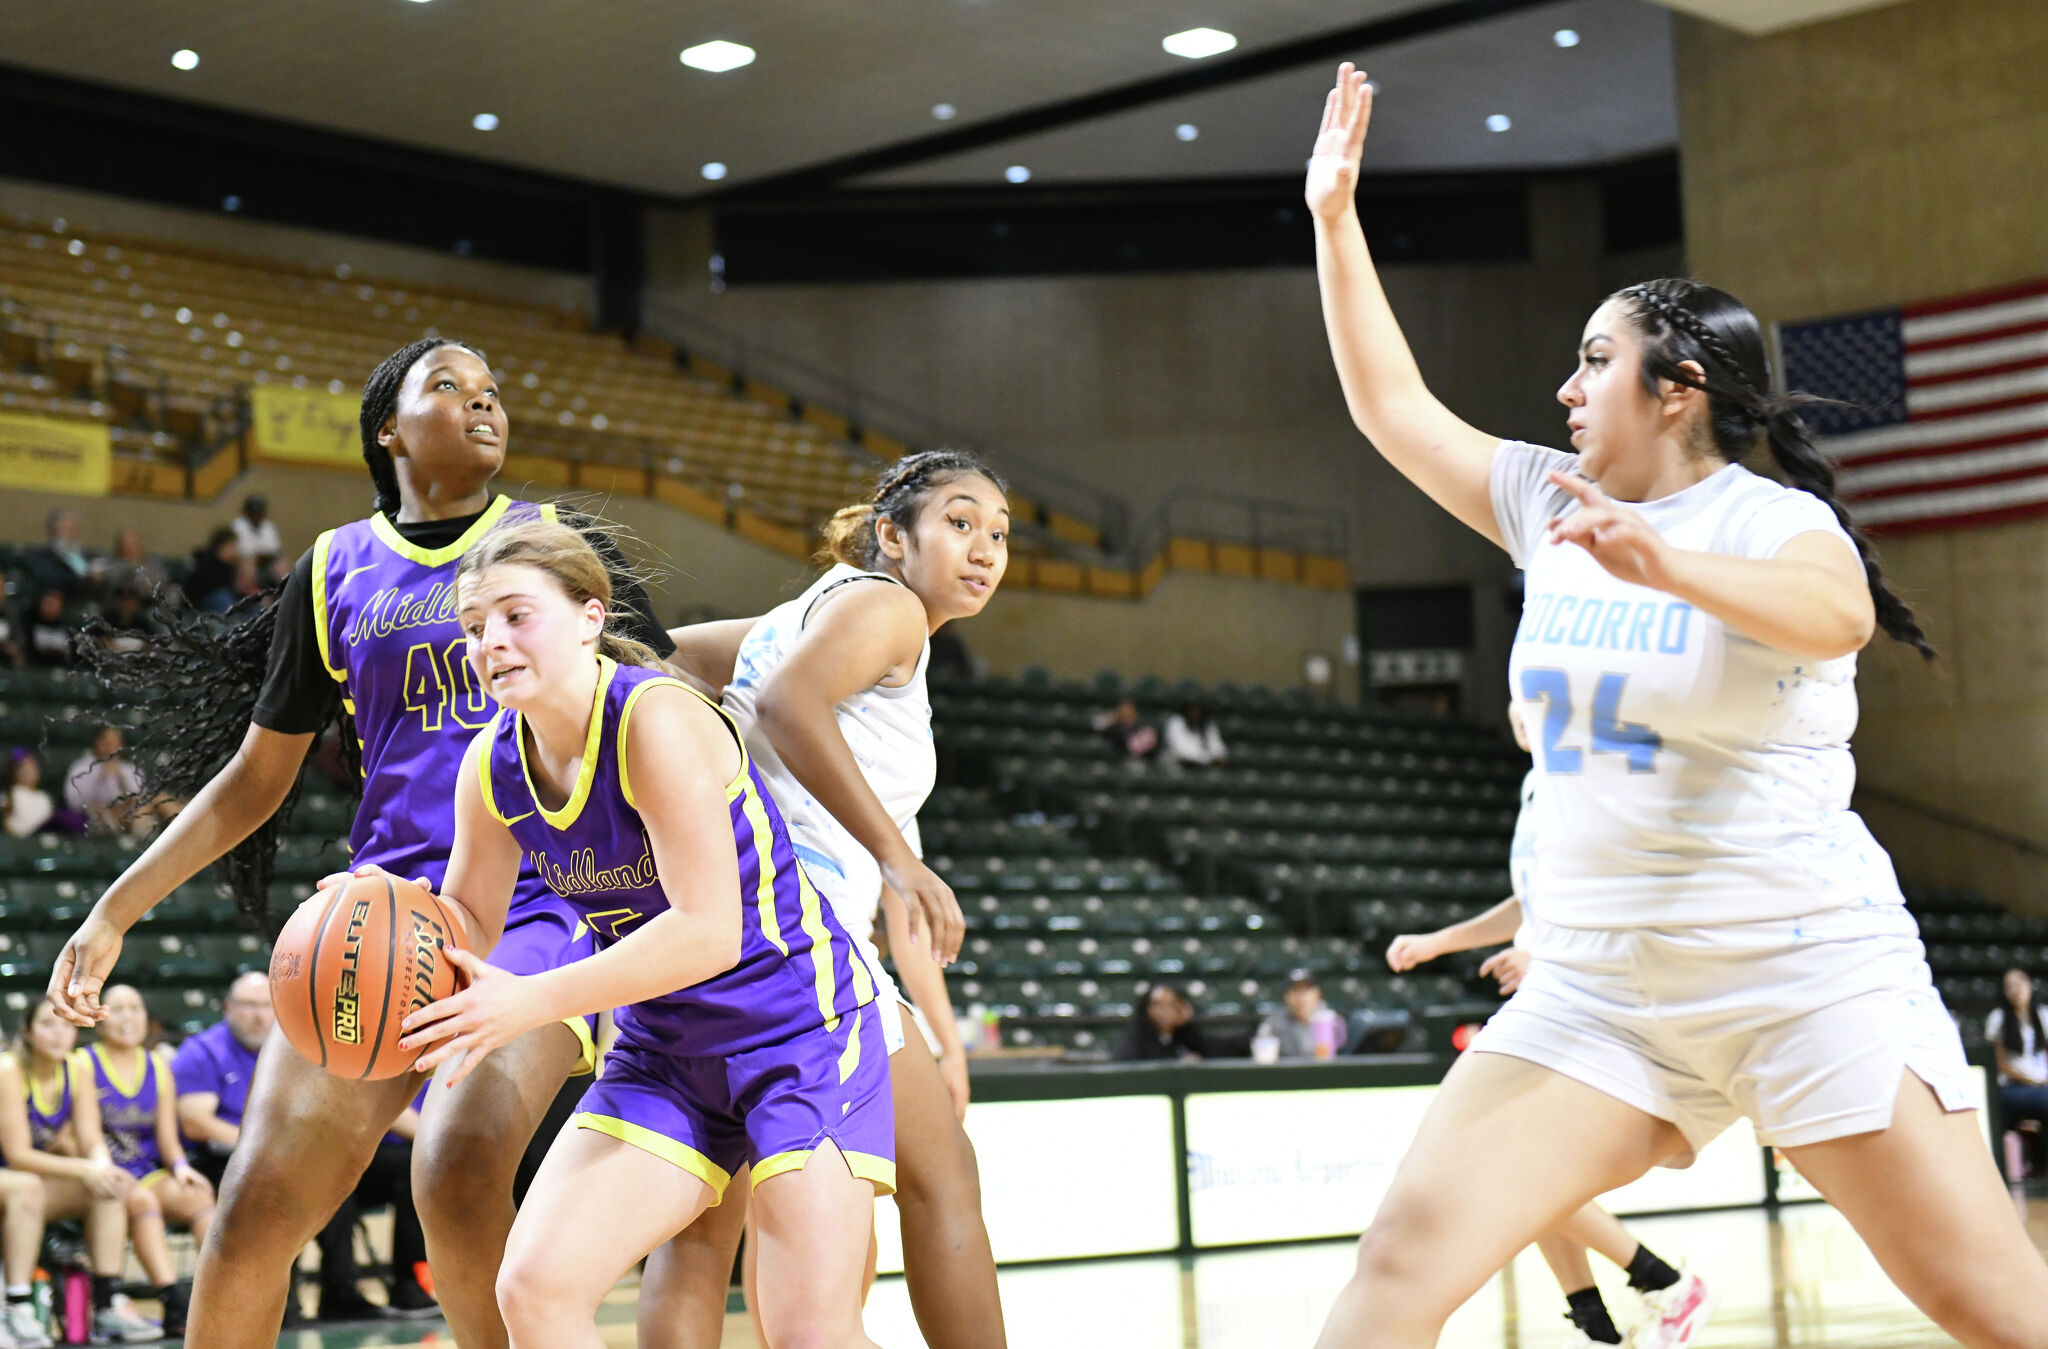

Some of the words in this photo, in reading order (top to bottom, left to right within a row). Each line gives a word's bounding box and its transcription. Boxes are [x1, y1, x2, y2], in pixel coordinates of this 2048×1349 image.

[348, 581, 461, 647] Midl
[1518, 593, 1692, 655] OCORRO
[402, 637, 504, 732] 40
[1519, 665, 1662, 775] 24
